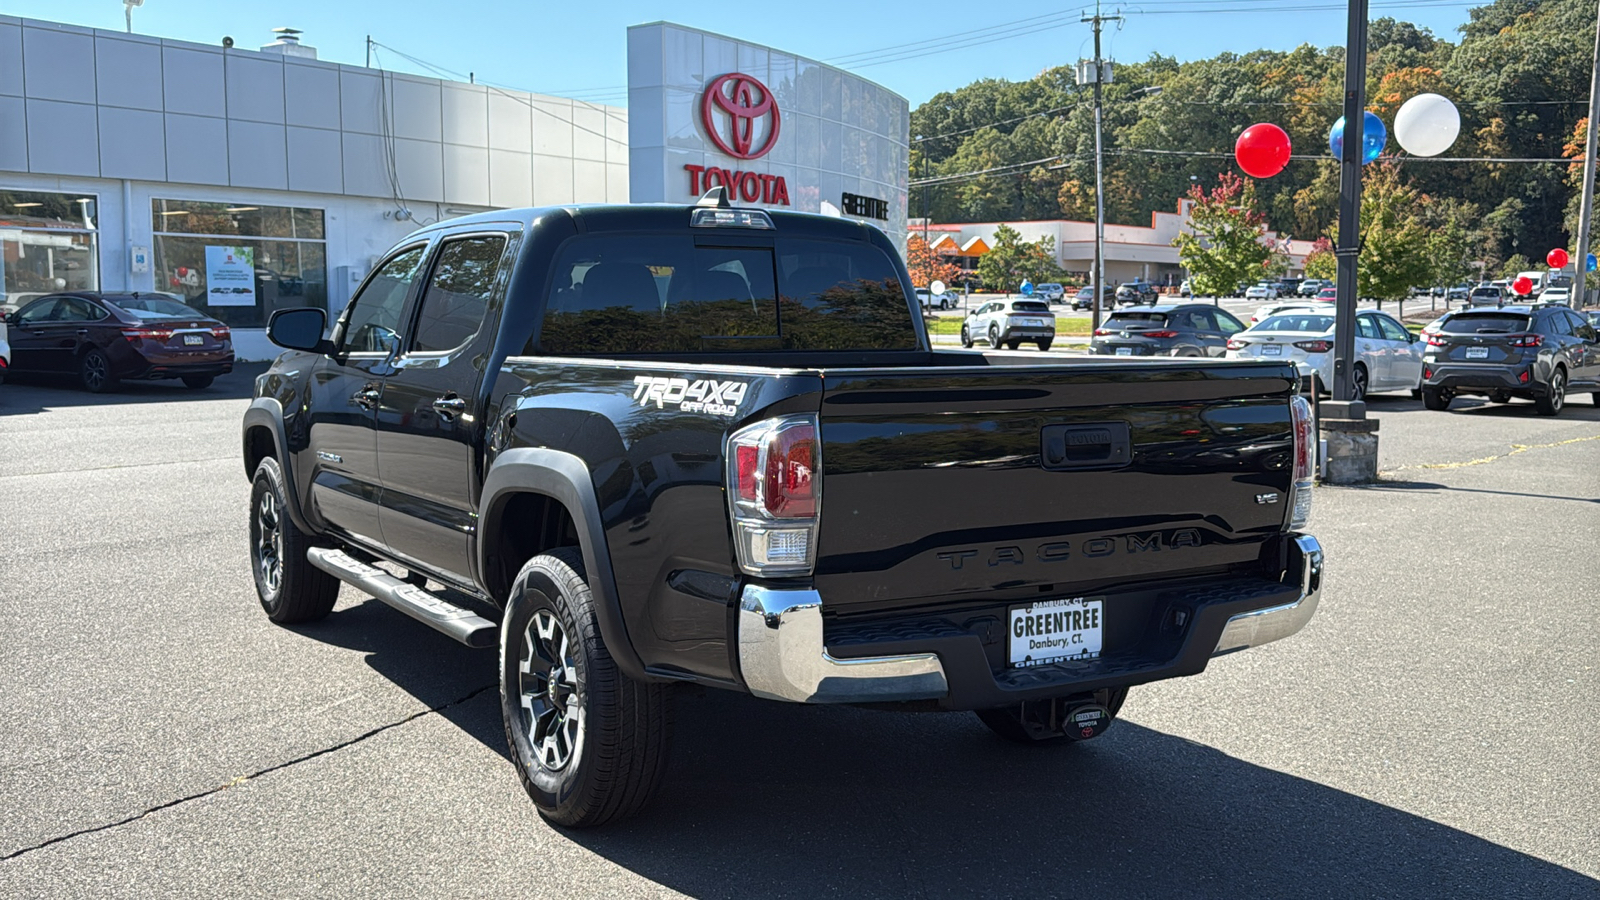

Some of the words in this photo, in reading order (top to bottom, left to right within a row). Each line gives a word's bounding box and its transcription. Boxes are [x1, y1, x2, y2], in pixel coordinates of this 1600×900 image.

[684, 164, 790, 206] TOYOTA
[703, 403, 737, 416] ROAD
[936, 528, 1202, 570] TACOMA
[1013, 608, 1099, 638] GREENTREE
[1029, 636, 1069, 650] Danbury,
[1071, 633, 1084, 645] CT.
[1014, 651, 1100, 668] GREENTREE
